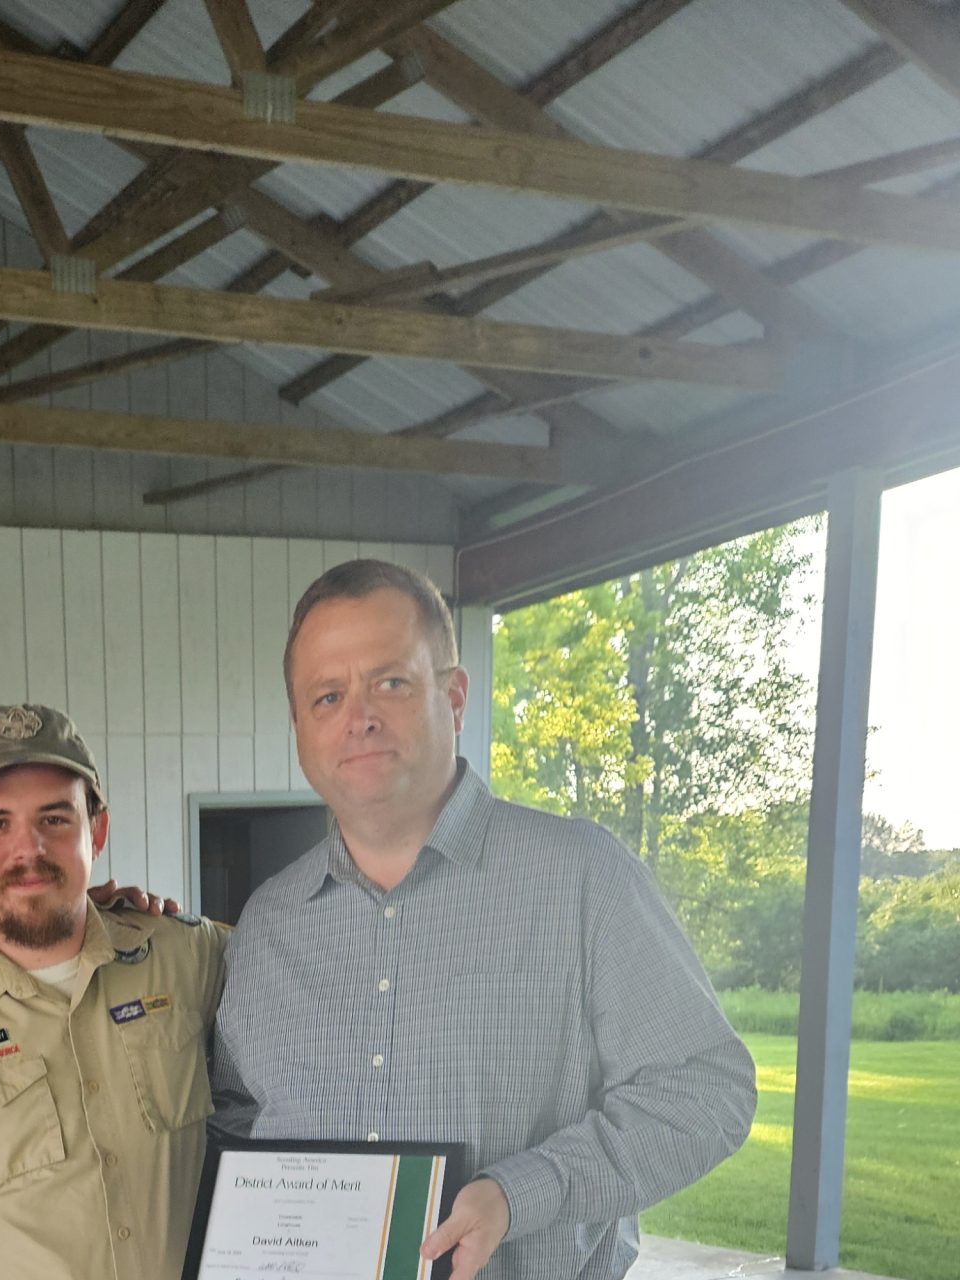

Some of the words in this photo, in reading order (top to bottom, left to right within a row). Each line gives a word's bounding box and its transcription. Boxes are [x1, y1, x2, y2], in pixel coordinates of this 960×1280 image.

[235, 1177, 273, 1190] District
[276, 1178, 314, 1190] Award
[316, 1179, 328, 1191] of
[331, 1180, 361, 1192] Merit
[252, 1236, 283, 1246] David
[285, 1237, 319, 1248] Aitken
